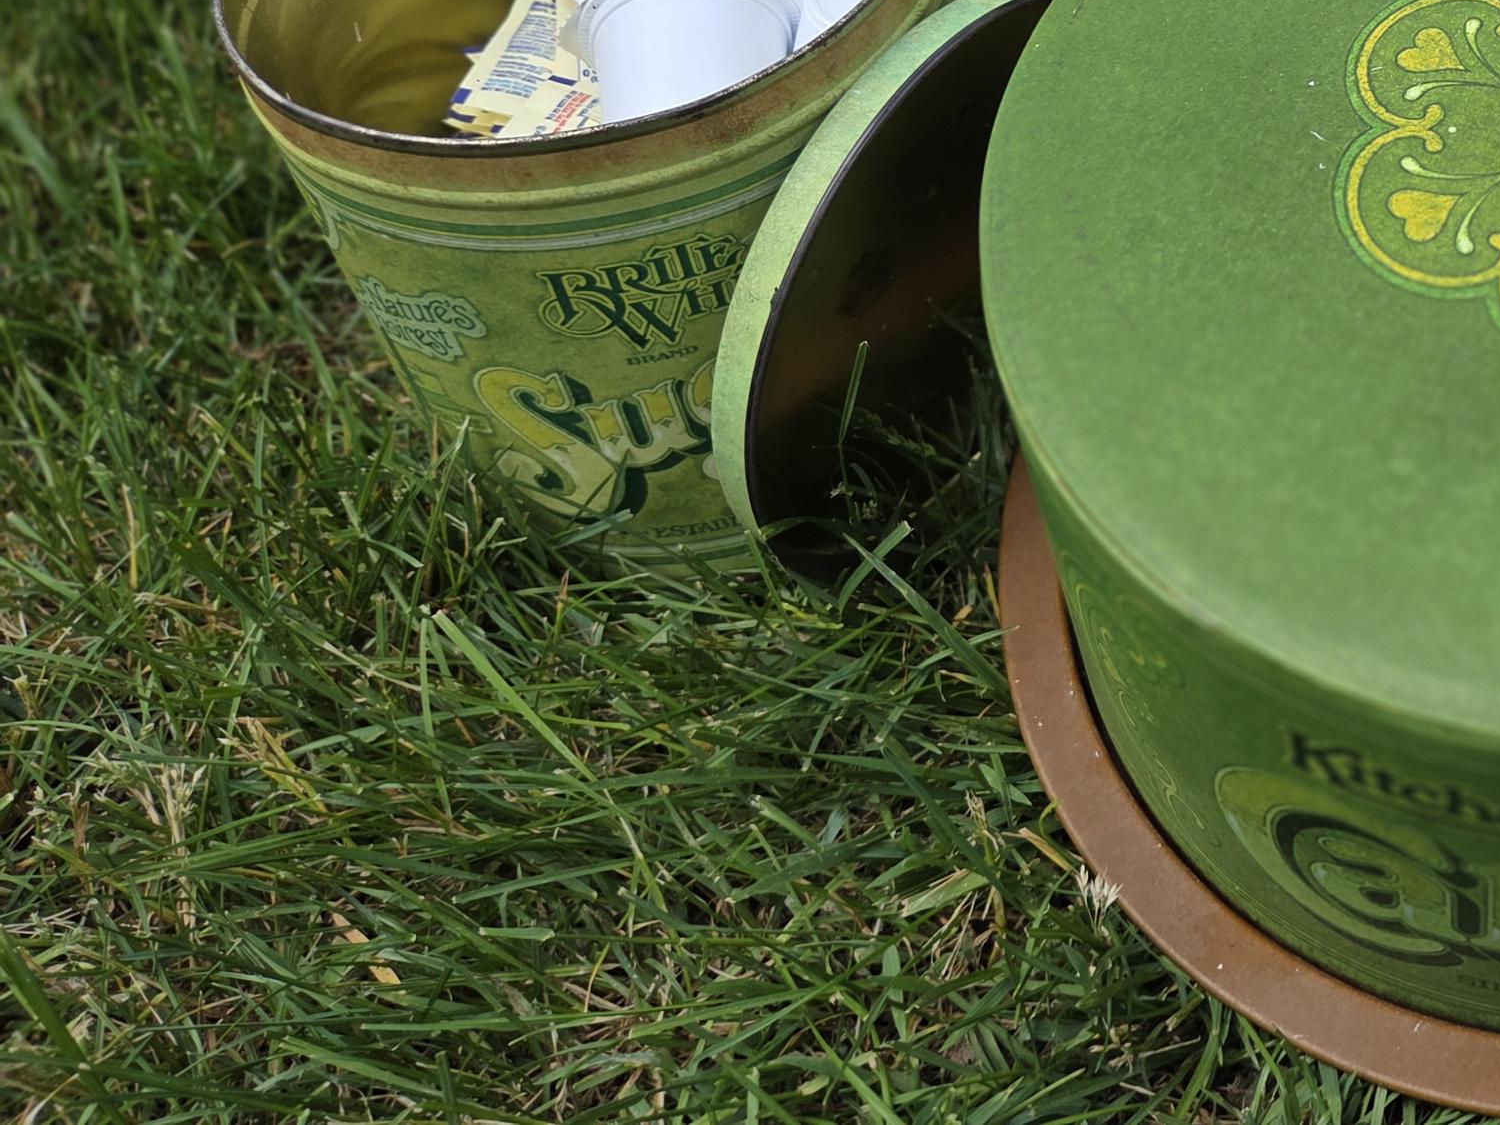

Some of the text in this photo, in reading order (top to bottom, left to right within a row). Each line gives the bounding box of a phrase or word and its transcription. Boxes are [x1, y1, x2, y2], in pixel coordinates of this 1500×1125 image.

[363, 282, 476, 330] Nature's
[537, 236, 744, 337] BRITE
[625, 345, 699, 365] BRAND
